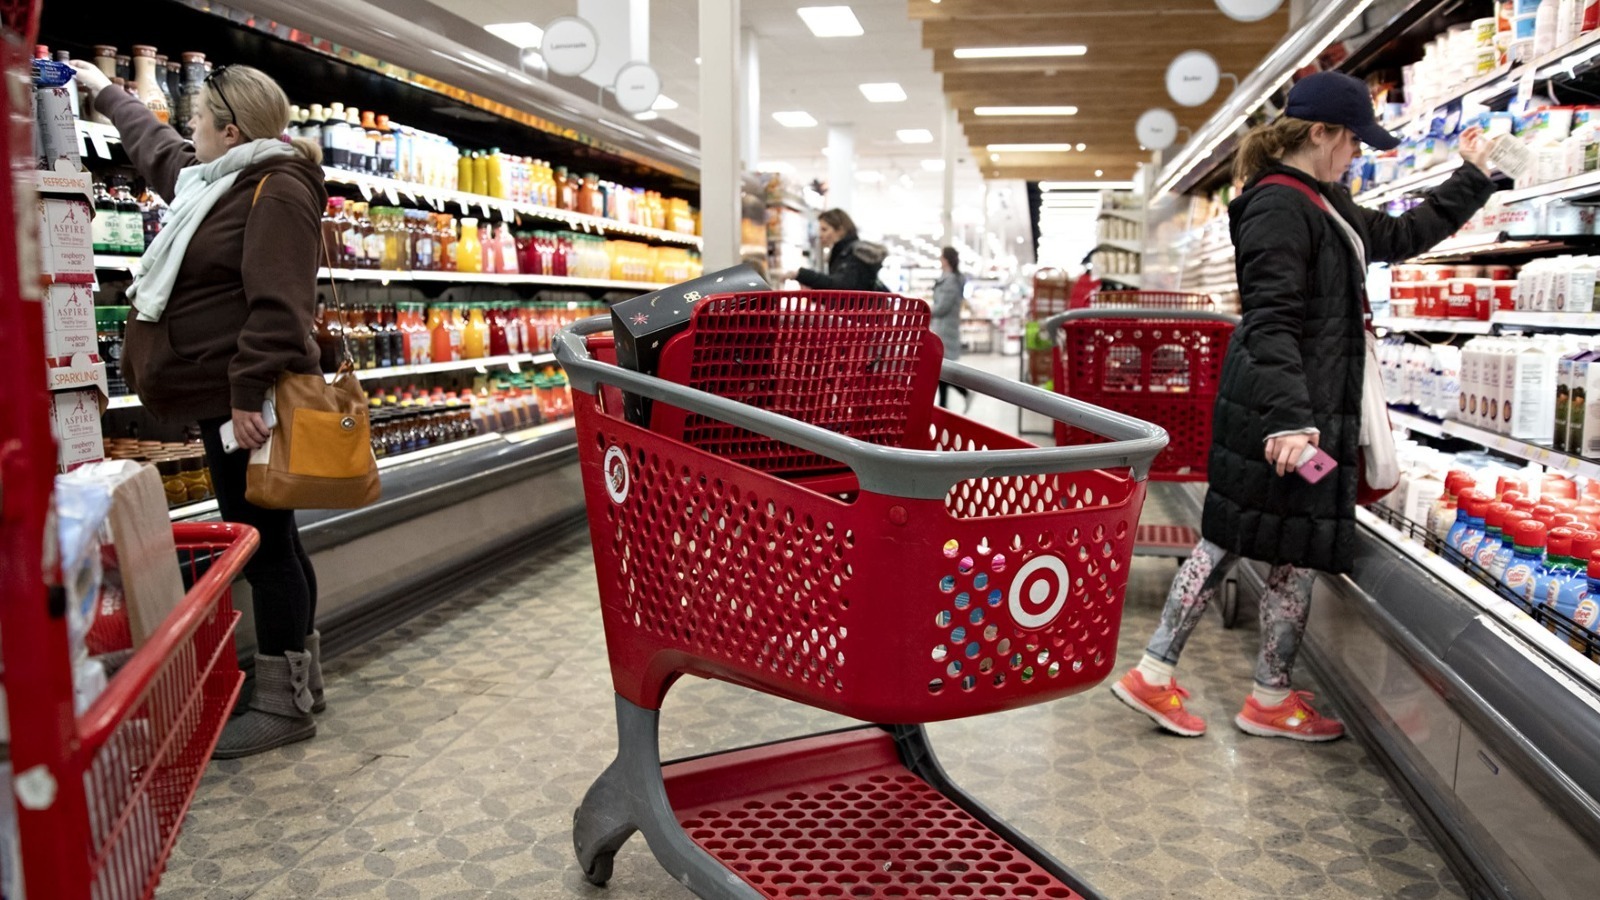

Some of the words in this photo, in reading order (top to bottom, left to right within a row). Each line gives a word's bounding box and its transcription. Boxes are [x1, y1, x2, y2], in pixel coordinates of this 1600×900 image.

[42, 176, 86, 189] REFRESHING
[53, 224, 85, 234] ASPIRE
[61, 252, 86, 261] raspberry
[57, 308, 88, 316] ASPIRE
[54, 370, 99, 386] SPARKLING
[64, 413, 95, 425] ASPIRE
